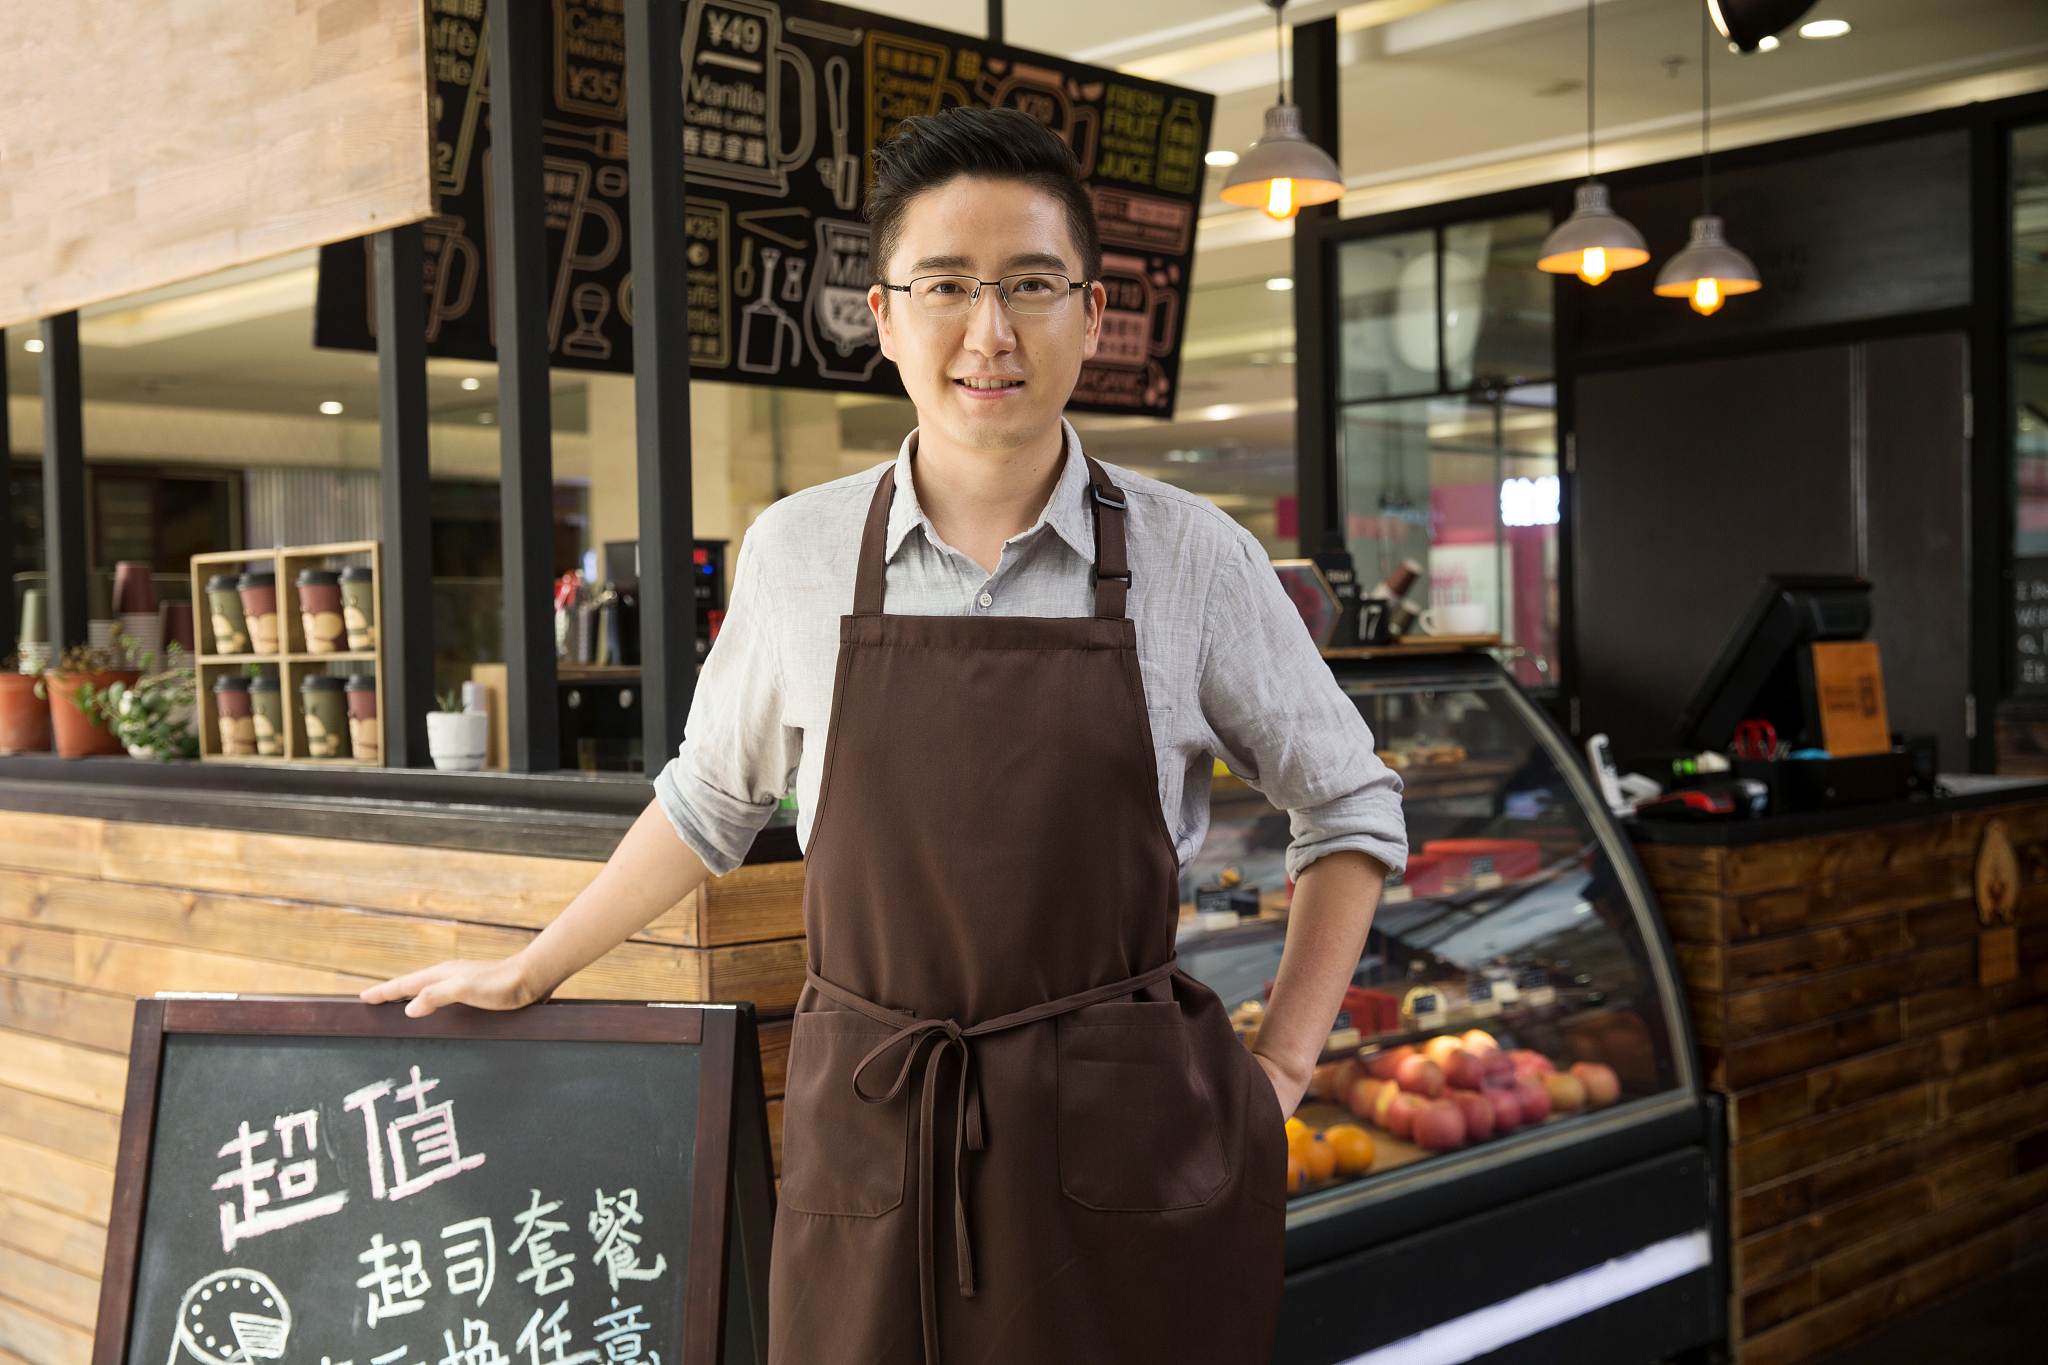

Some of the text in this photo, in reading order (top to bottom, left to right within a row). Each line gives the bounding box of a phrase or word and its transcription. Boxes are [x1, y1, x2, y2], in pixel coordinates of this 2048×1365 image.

[707, 9, 761, 53] ¥49
[691, 72, 766, 115] Vanilla
[1097, 151, 1154, 185] JUICE
[1359, 604, 1382, 640] 17
[210, 1064, 487, 1253] 超值
[355, 1187, 667, 1328] 起司套餐
